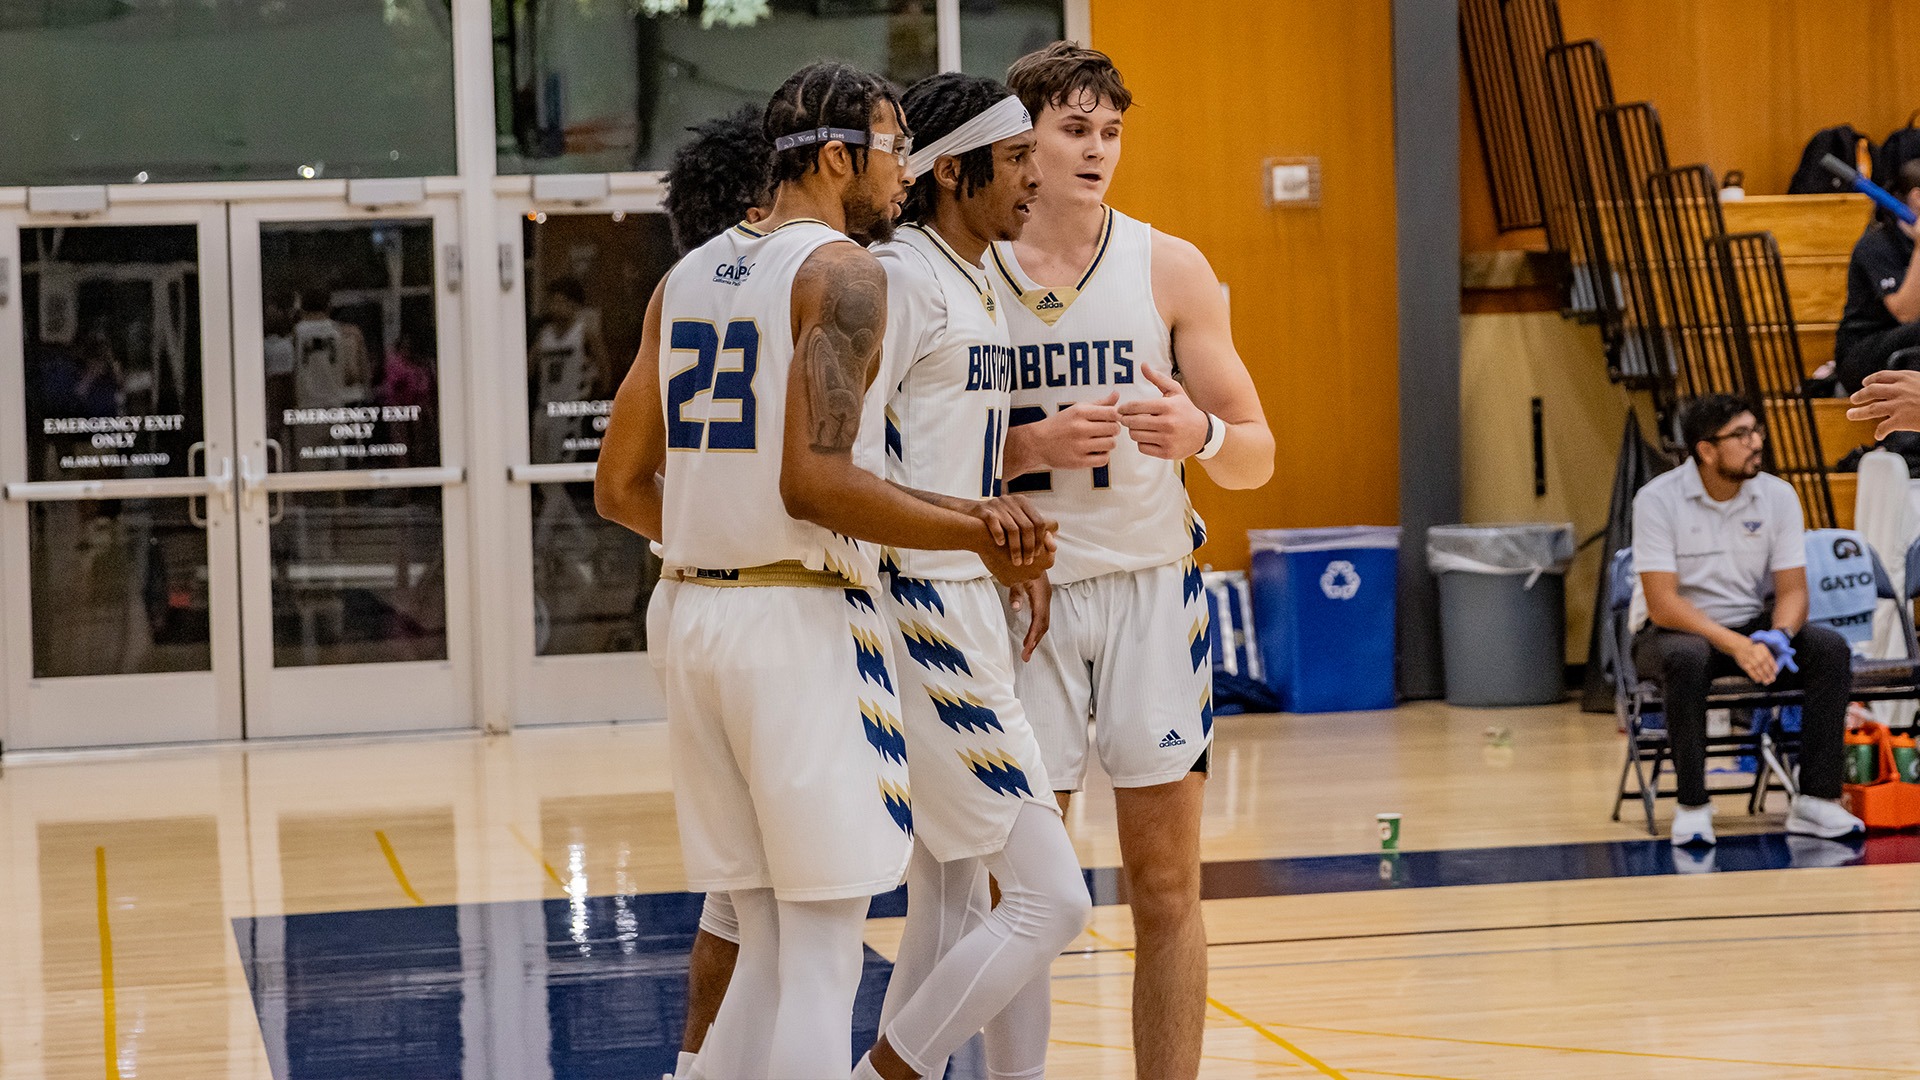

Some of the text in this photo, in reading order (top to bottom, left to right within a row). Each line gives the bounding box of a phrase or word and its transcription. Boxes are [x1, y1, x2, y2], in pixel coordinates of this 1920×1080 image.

[1036, 301, 1063, 310] adidas
[1010, 340, 1134, 391] BCATS
[666, 317, 762, 453] 23
[283, 405, 421, 425] EMERGENCY EXIT
[546, 400, 613, 417] EMERGE
[43, 414, 184, 434] EMERGENCY EXIT
[330, 423, 375, 439] ONLY
[91, 432, 137, 449] ONLY
[1159, 738, 1187, 749] adidas
